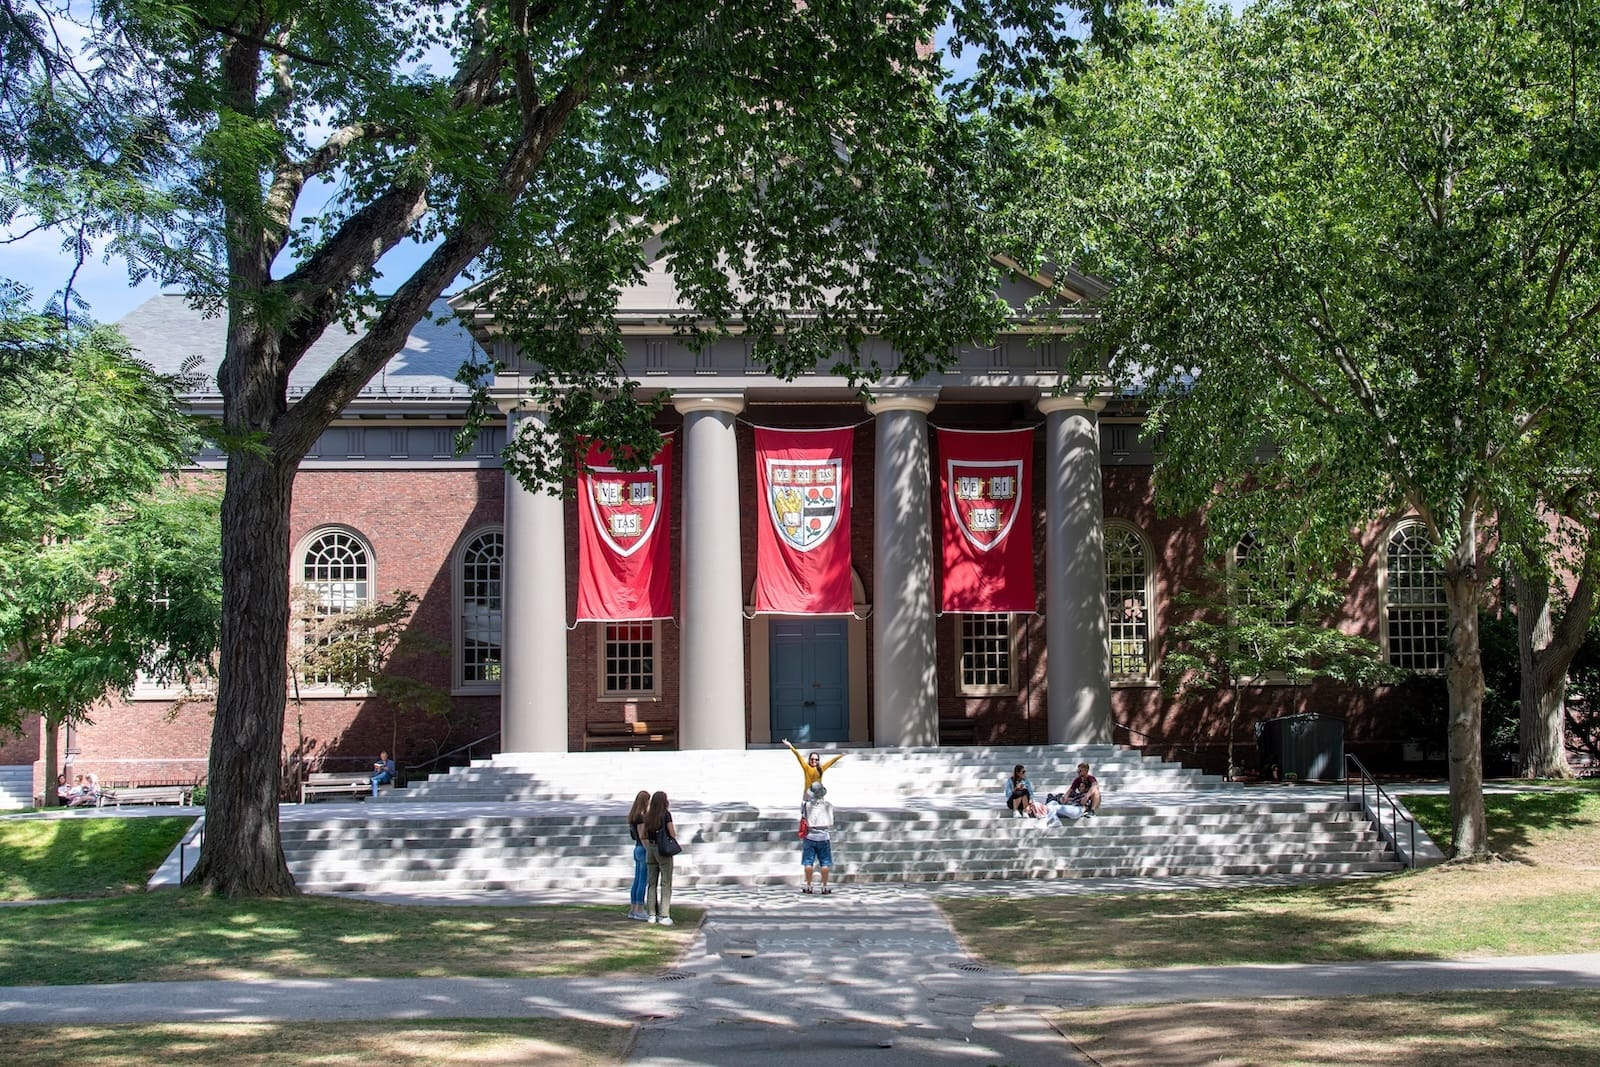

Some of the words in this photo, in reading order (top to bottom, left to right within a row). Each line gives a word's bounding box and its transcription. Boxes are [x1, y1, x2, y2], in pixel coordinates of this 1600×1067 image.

[963, 482, 977, 492] VE
[994, 482, 1006, 492] RI
[602, 487, 617, 498] VE
[634, 487, 647, 498] RI
[976, 513, 995, 523] TAS
[616, 519, 635, 528] TAS
